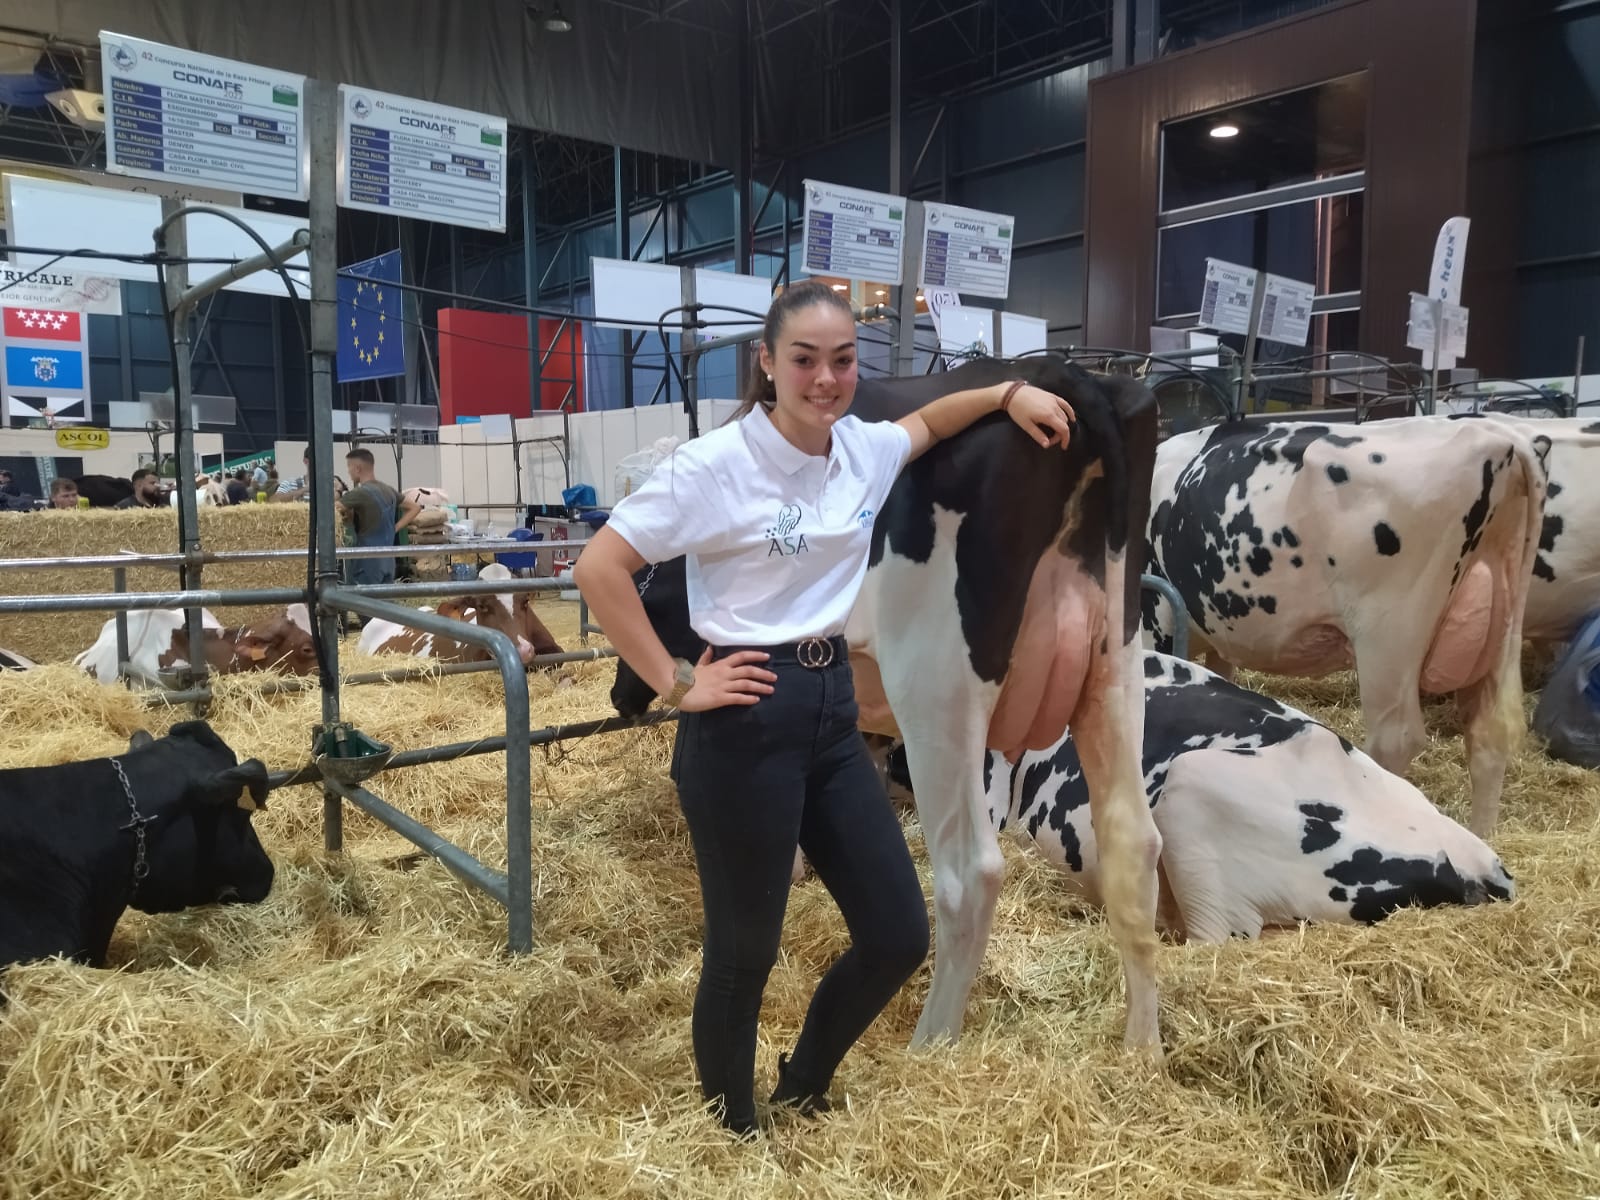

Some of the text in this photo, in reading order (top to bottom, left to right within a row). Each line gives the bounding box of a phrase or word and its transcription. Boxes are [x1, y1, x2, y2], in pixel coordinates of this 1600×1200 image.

[142, 51, 153, 61] 42
[155, 56, 186, 68] Concurso
[173, 70, 243, 94] CONAFE
[224, 89, 244, 100] 2022
[399, 116, 457, 136] CONAFE
[839, 201, 875, 215] CONAFE
[768, 534, 809, 557] ASA
